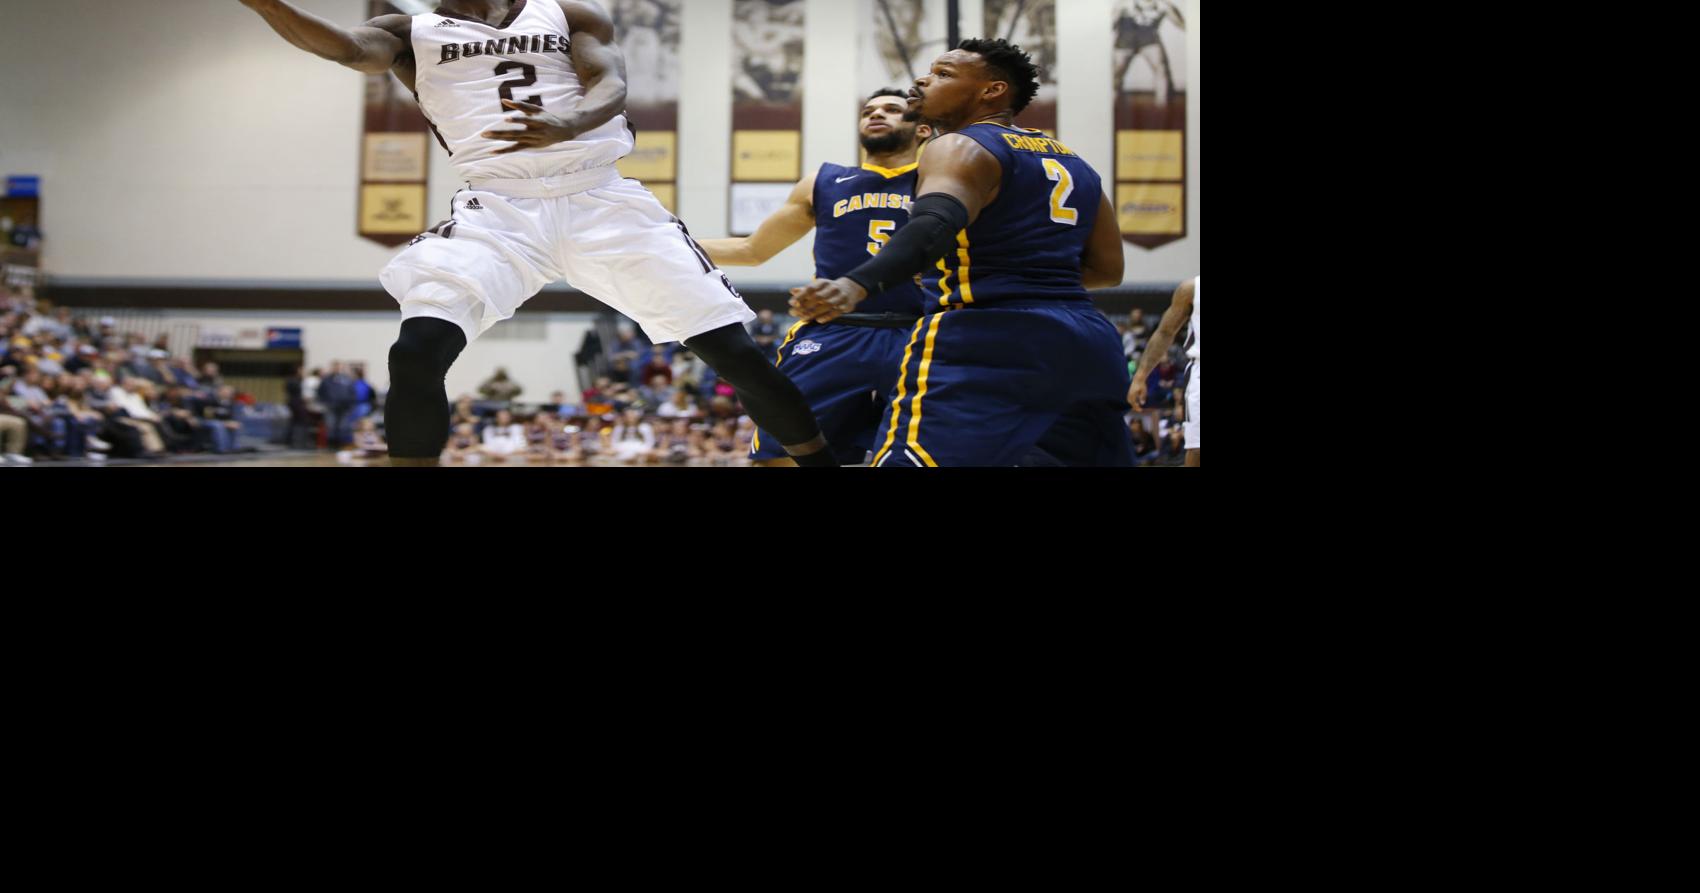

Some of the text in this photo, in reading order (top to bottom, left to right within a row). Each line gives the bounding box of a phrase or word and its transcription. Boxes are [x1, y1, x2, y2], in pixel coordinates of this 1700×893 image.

[437, 34, 570, 65] BONNIES
[494, 61, 543, 112] 2
[1041, 158, 1078, 226] 2
[866, 219, 896, 256] 5
